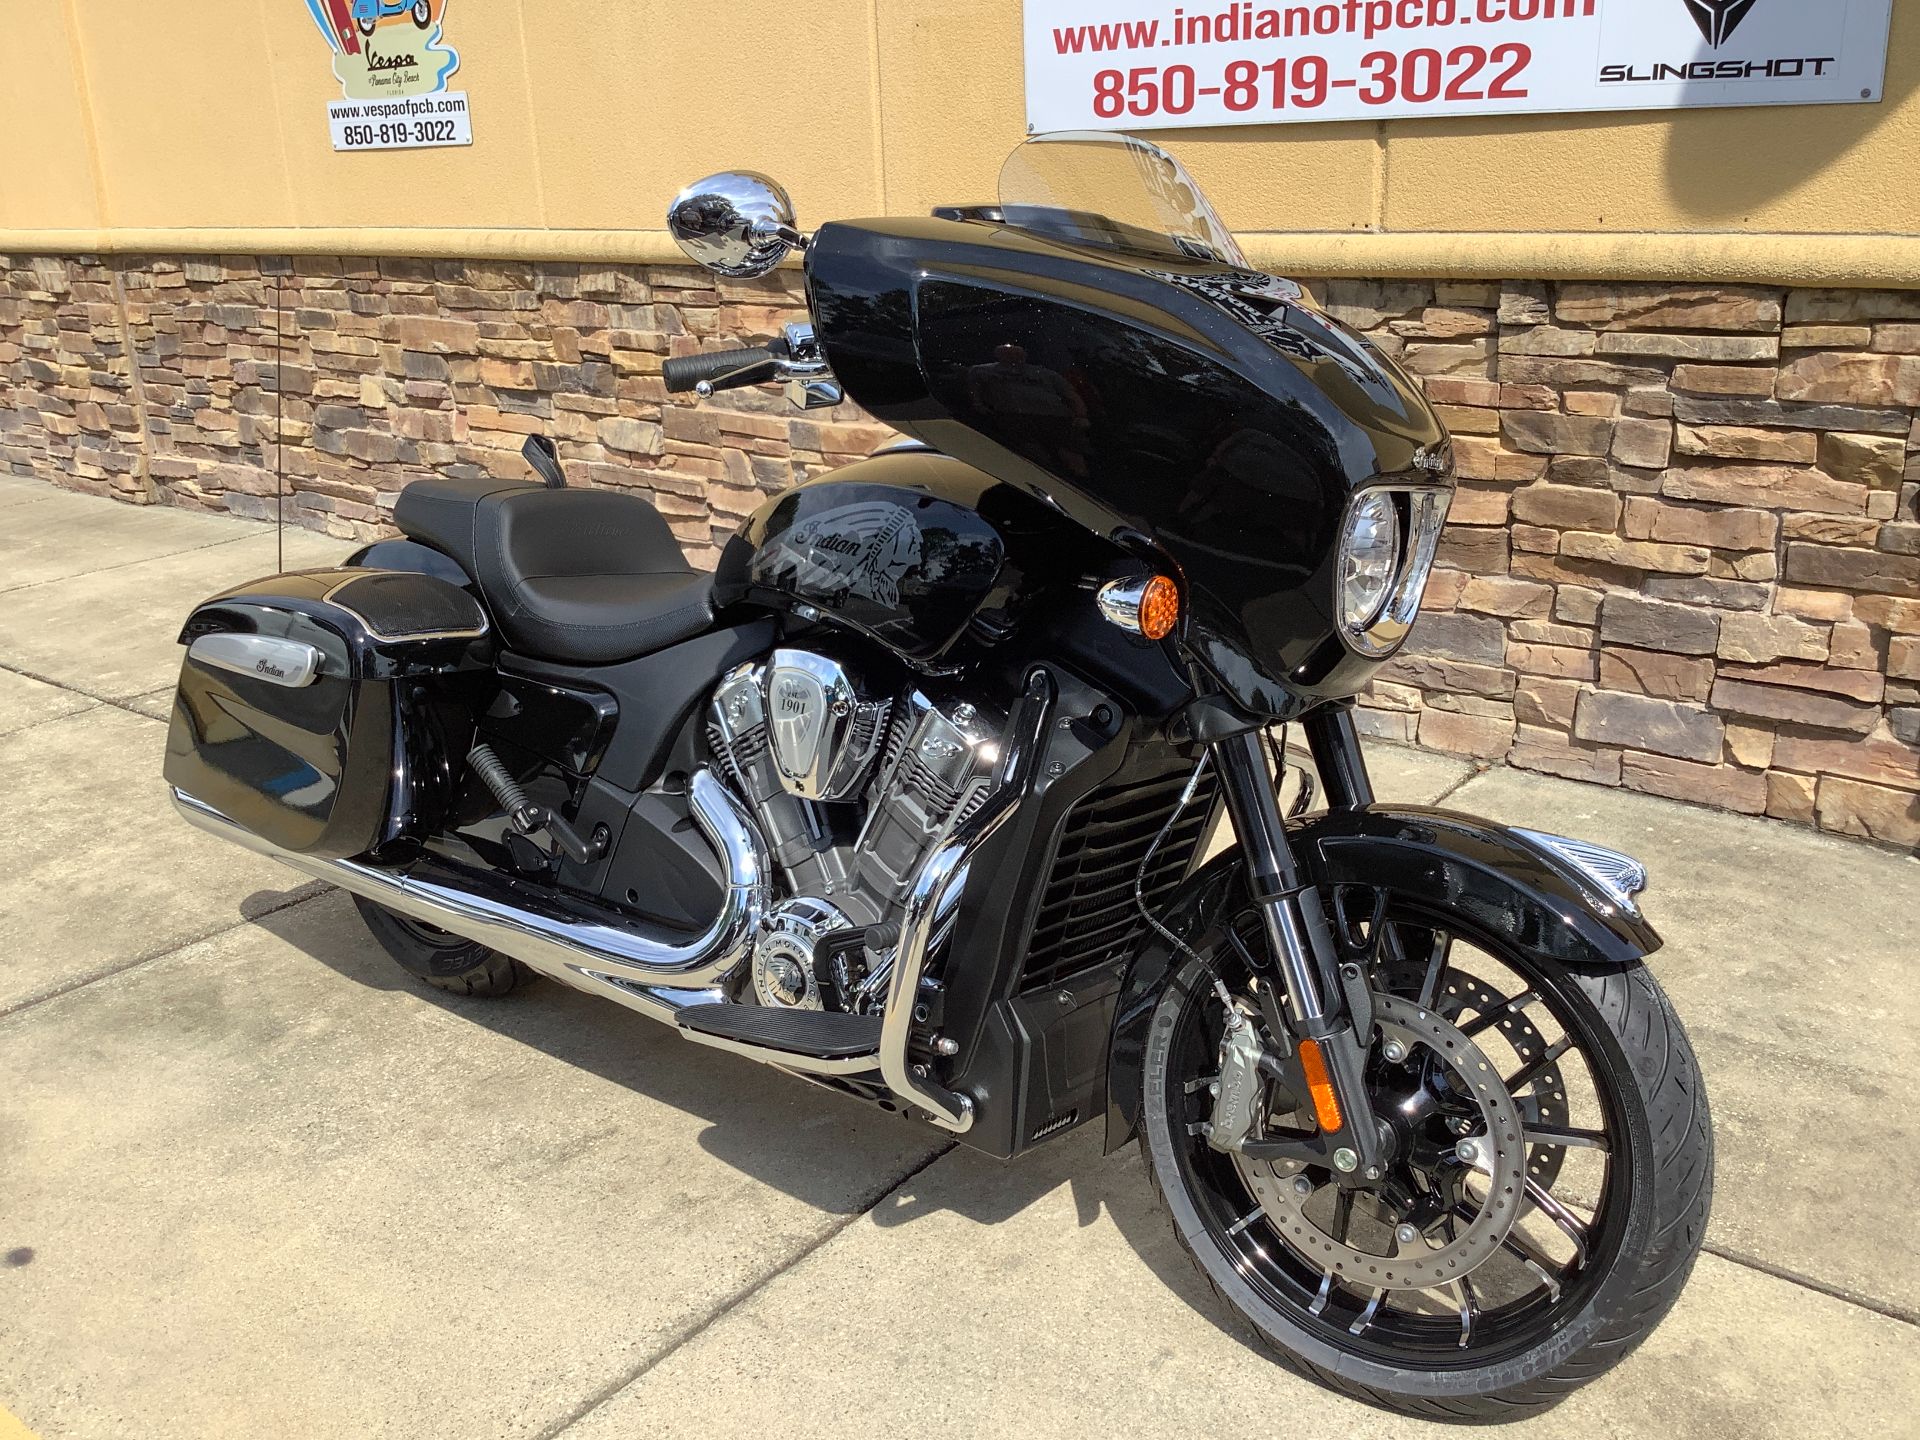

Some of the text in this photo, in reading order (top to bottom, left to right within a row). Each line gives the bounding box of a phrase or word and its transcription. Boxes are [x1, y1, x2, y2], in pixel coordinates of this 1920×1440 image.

[1053, 0, 1595, 55] www.indianofpcb.com
[364, 38, 418, 71] Vespa
[392, 71, 403, 88] City
[403, 70, 420, 84] Beach
[1092, 42, 1533, 119] 850-819-3022
[1600, 57, 1835, 83] SLINGSHOT
[330, 98, 466, 119] www.vespaofpcb.com
[343, 120, 457, 146] 850-819-3022
[794, 520, 861, 556] Indian
[256, 659, 285, 679] Indian
[781, 699, 806, 715] 1901
[757, 946, 772, 994] INDIAN
